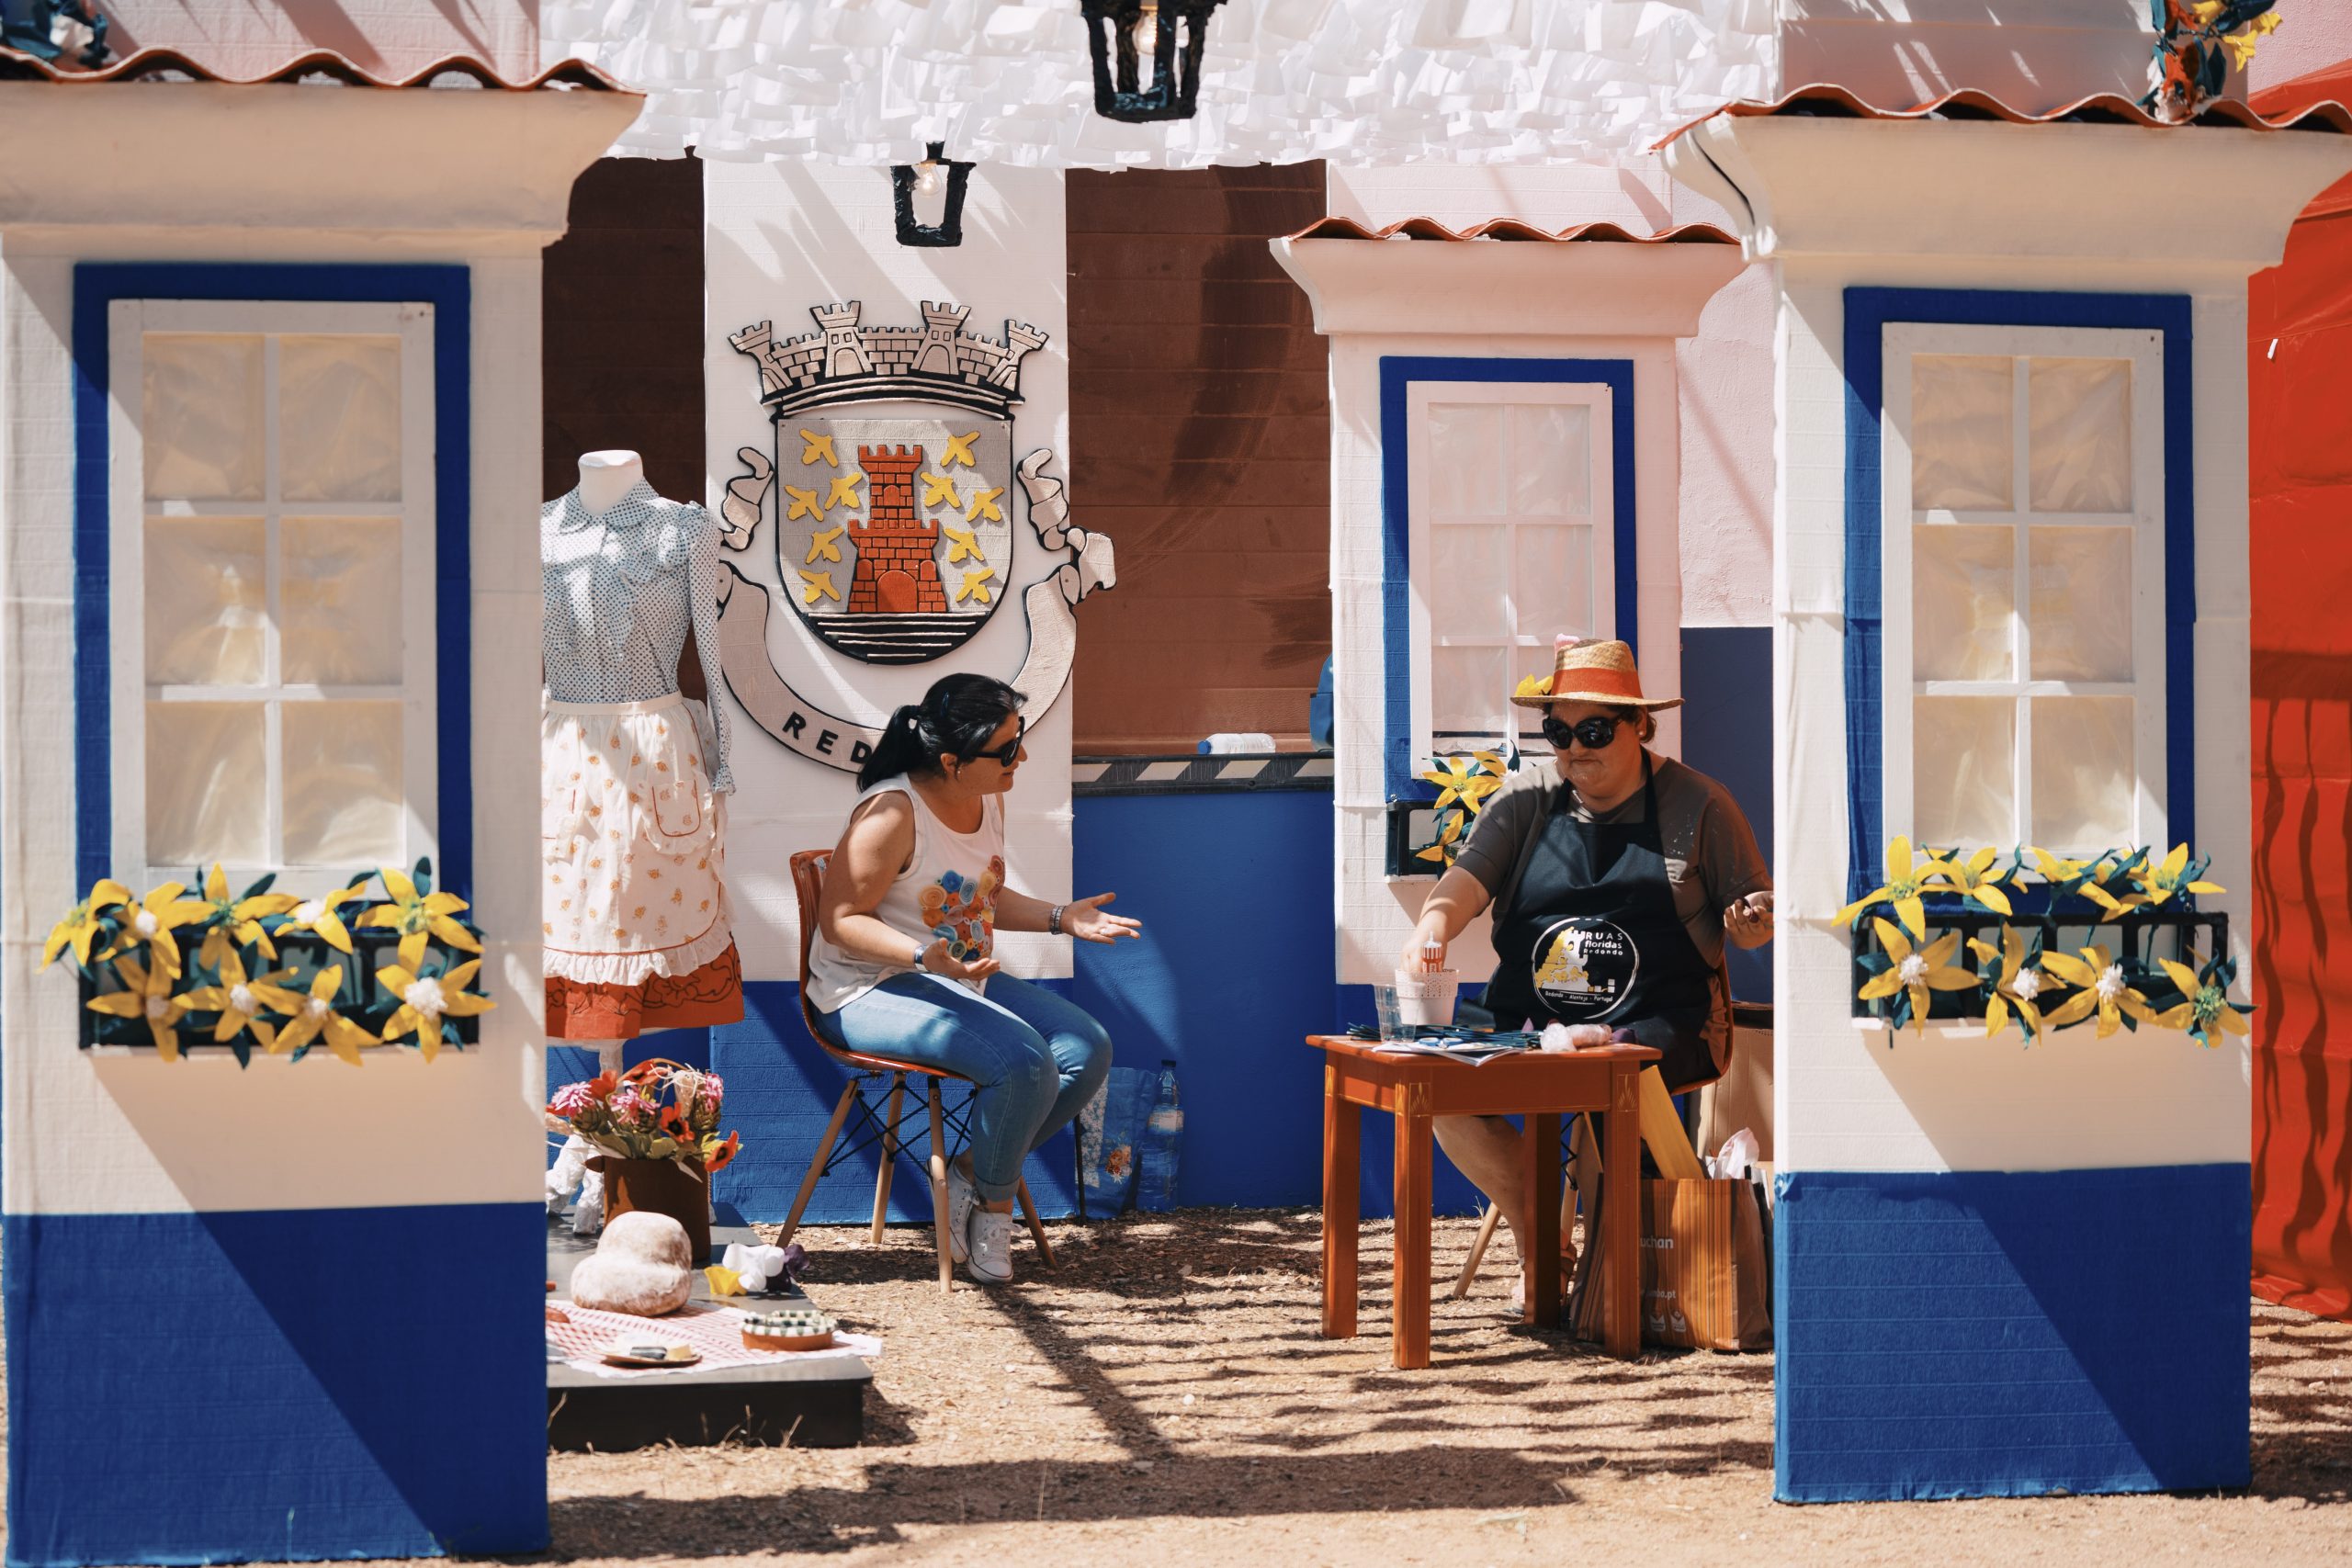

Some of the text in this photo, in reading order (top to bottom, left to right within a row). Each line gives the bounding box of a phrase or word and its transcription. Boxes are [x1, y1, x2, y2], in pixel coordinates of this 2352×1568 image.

[782, 711, 873, 764] RED
[1586, 931, 1623, 940] RUAS
[1585, 940, 1623, 949] floridas
[1639, 1236, 1674, 1249] uchan
